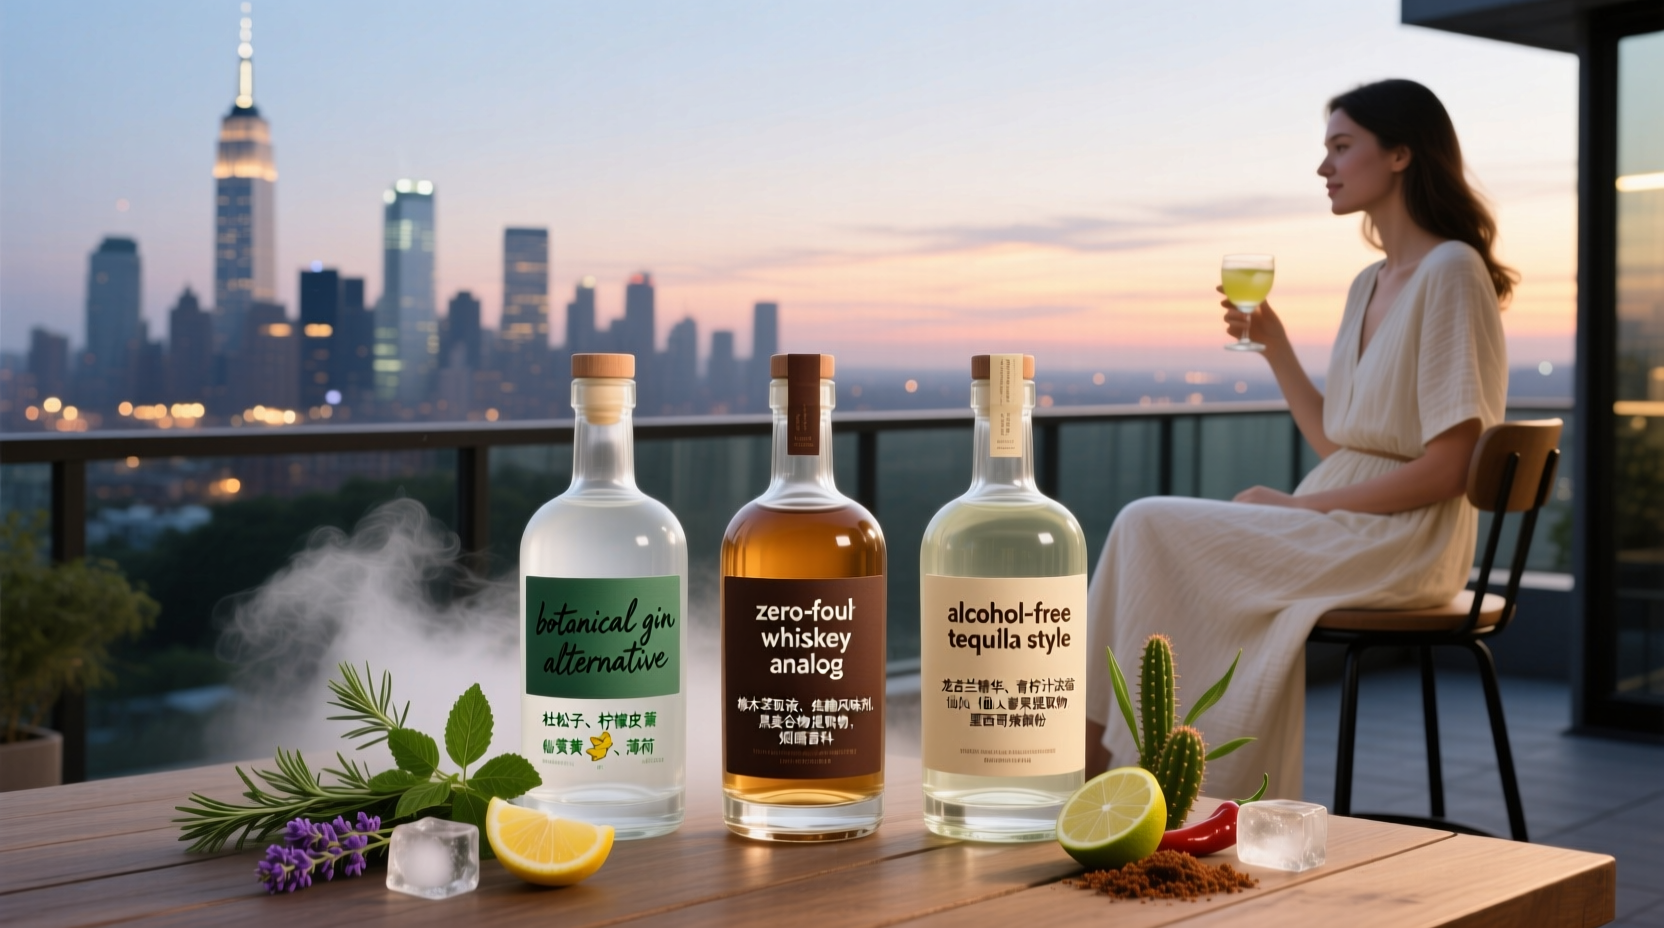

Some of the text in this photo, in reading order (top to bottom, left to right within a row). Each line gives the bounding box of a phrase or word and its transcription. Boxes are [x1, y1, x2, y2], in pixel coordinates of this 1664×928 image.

[536, 598, 675, 646] botanical gin
[947, 601, 1071, 624] alcohol-free
[761, 626, 851, 653] whiskey
[947, 626, 1071, 656] tequila style
[543, 641, 669, 675] alternative
[769, 653, 843, 680] analog
